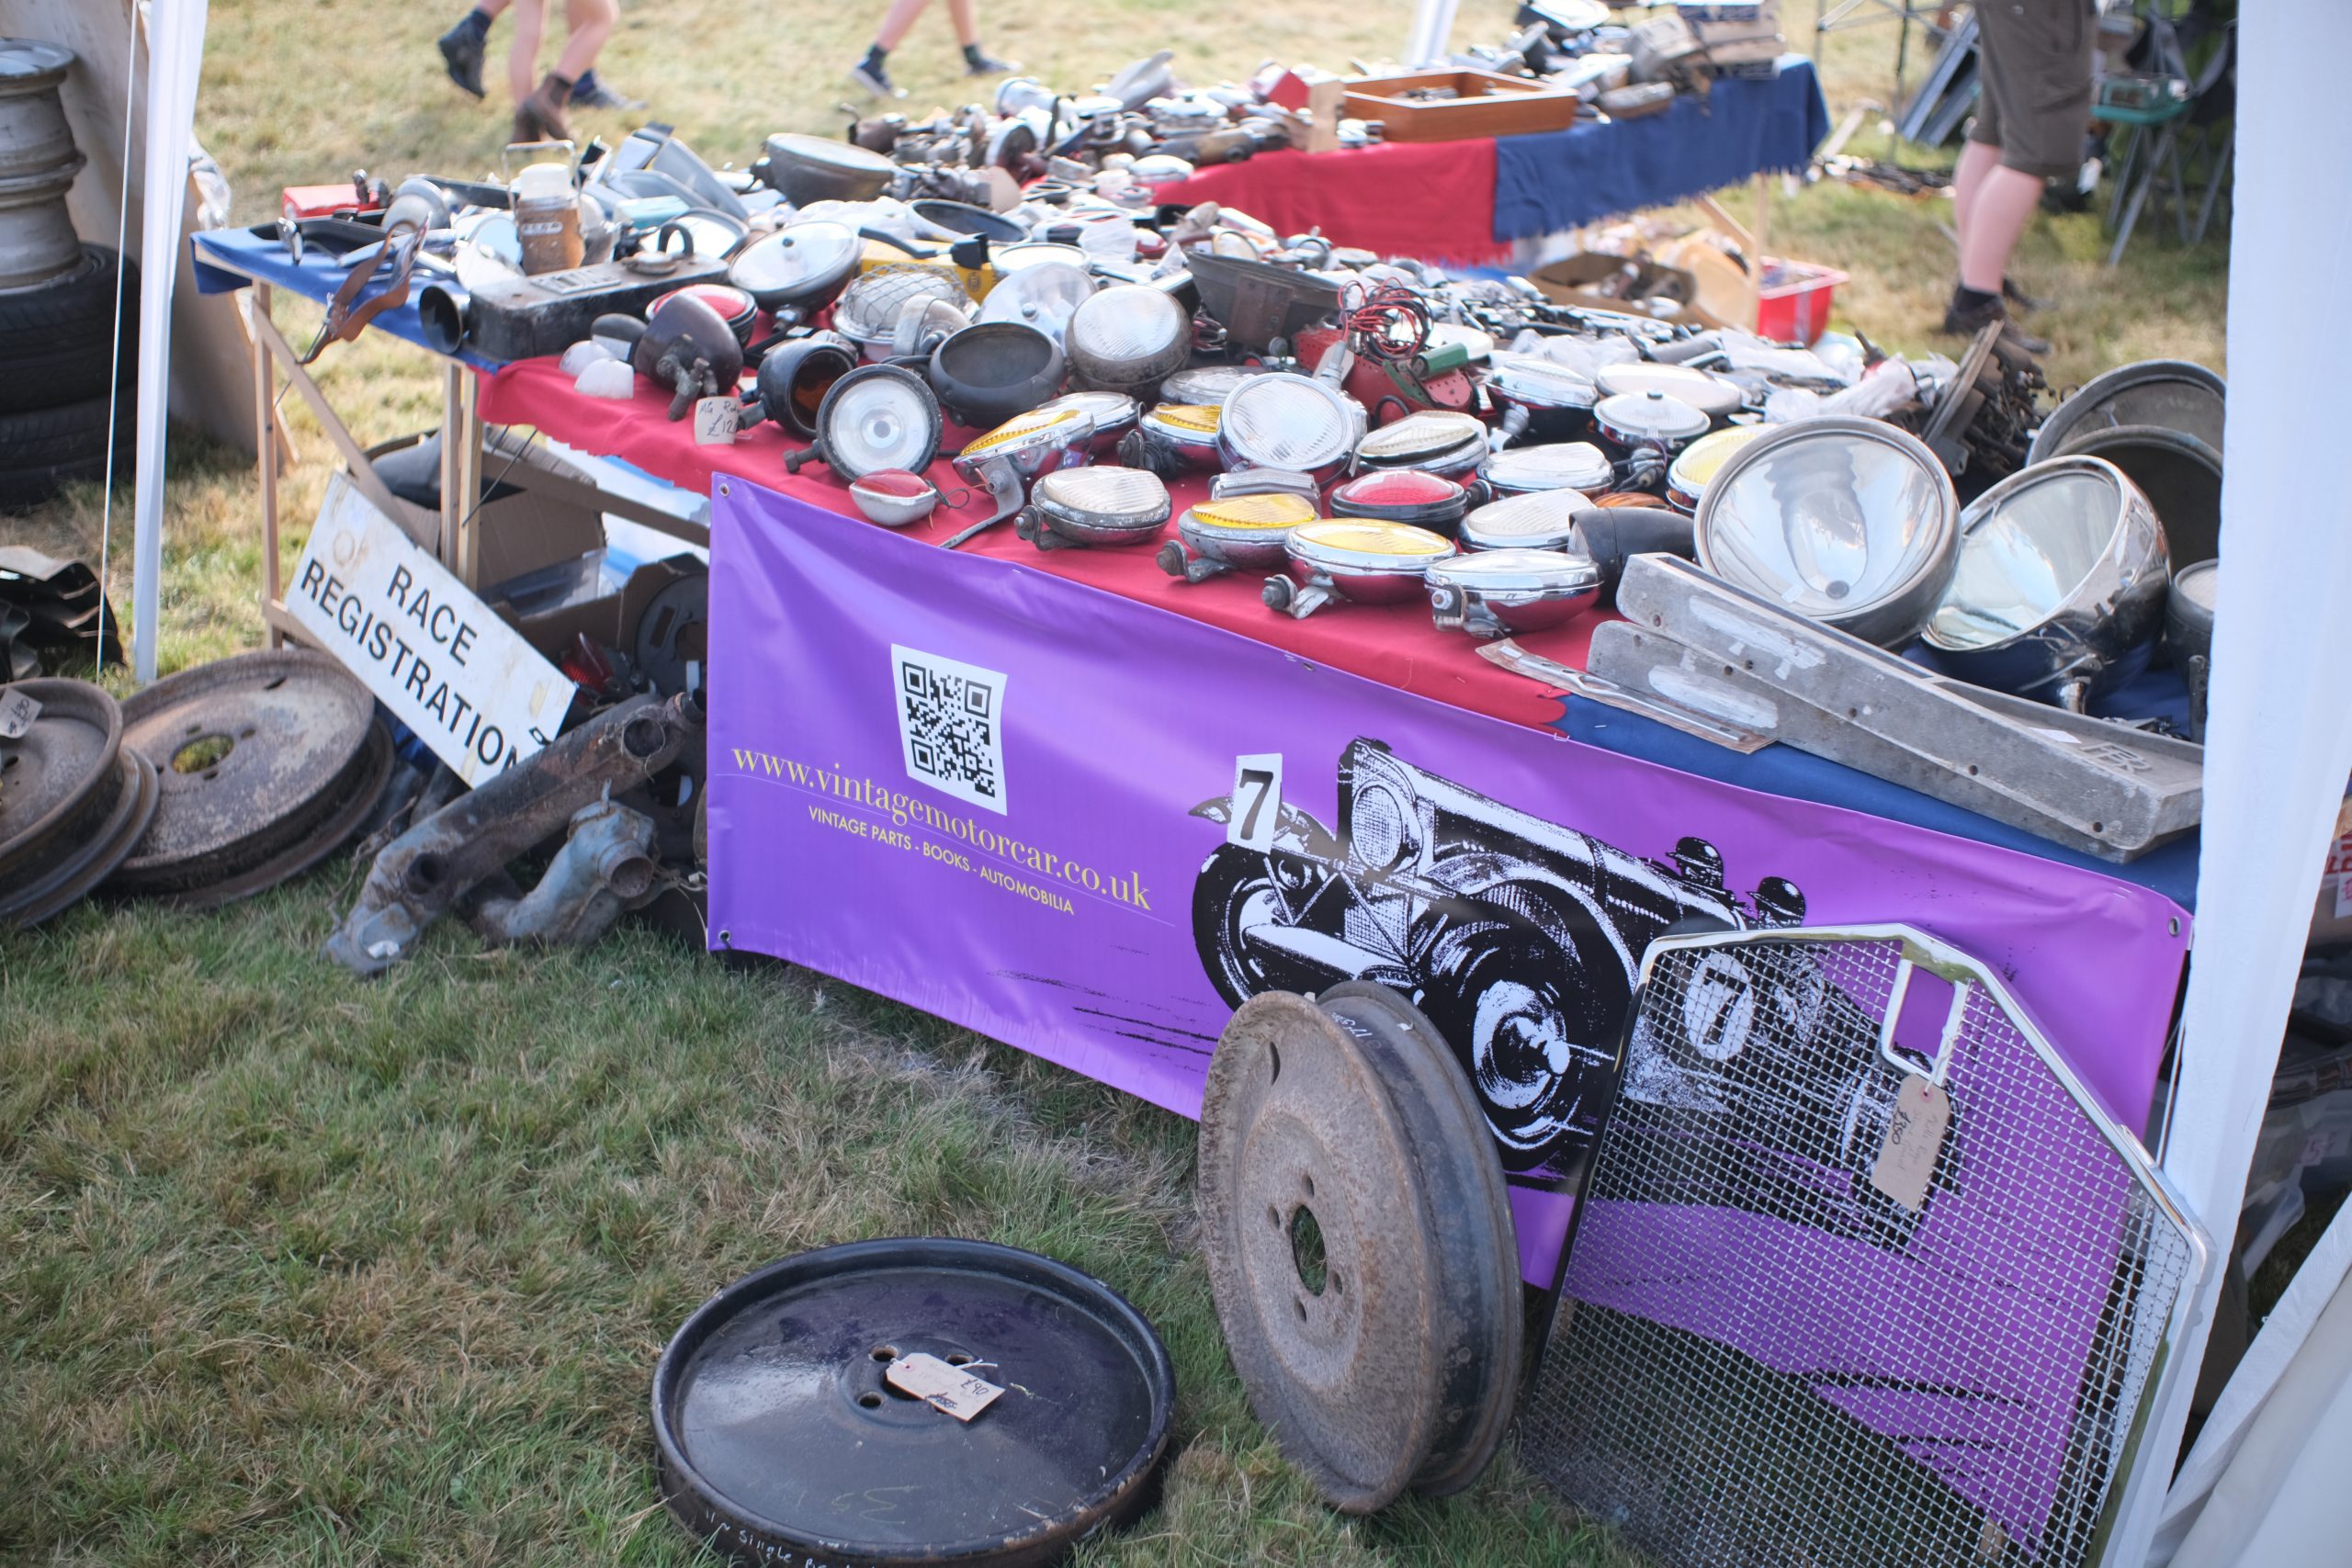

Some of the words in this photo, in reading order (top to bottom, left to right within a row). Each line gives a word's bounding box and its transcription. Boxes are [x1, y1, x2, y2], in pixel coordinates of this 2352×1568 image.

[386, 564, 478, 667] RACE
[731, 748, 1152, 911] www.vintagemotorcar.co.uk
[1238, 768, 1274, 841] 7
[808, 805, 868, 838] VINTAGE
[871, 823, 912, 851] PARTS
[922, 840, 970, 873] BOOKS
[979, 864, 1075, 916] AUTOMOBILIA
[960, 1378, 990, 1395] £90
